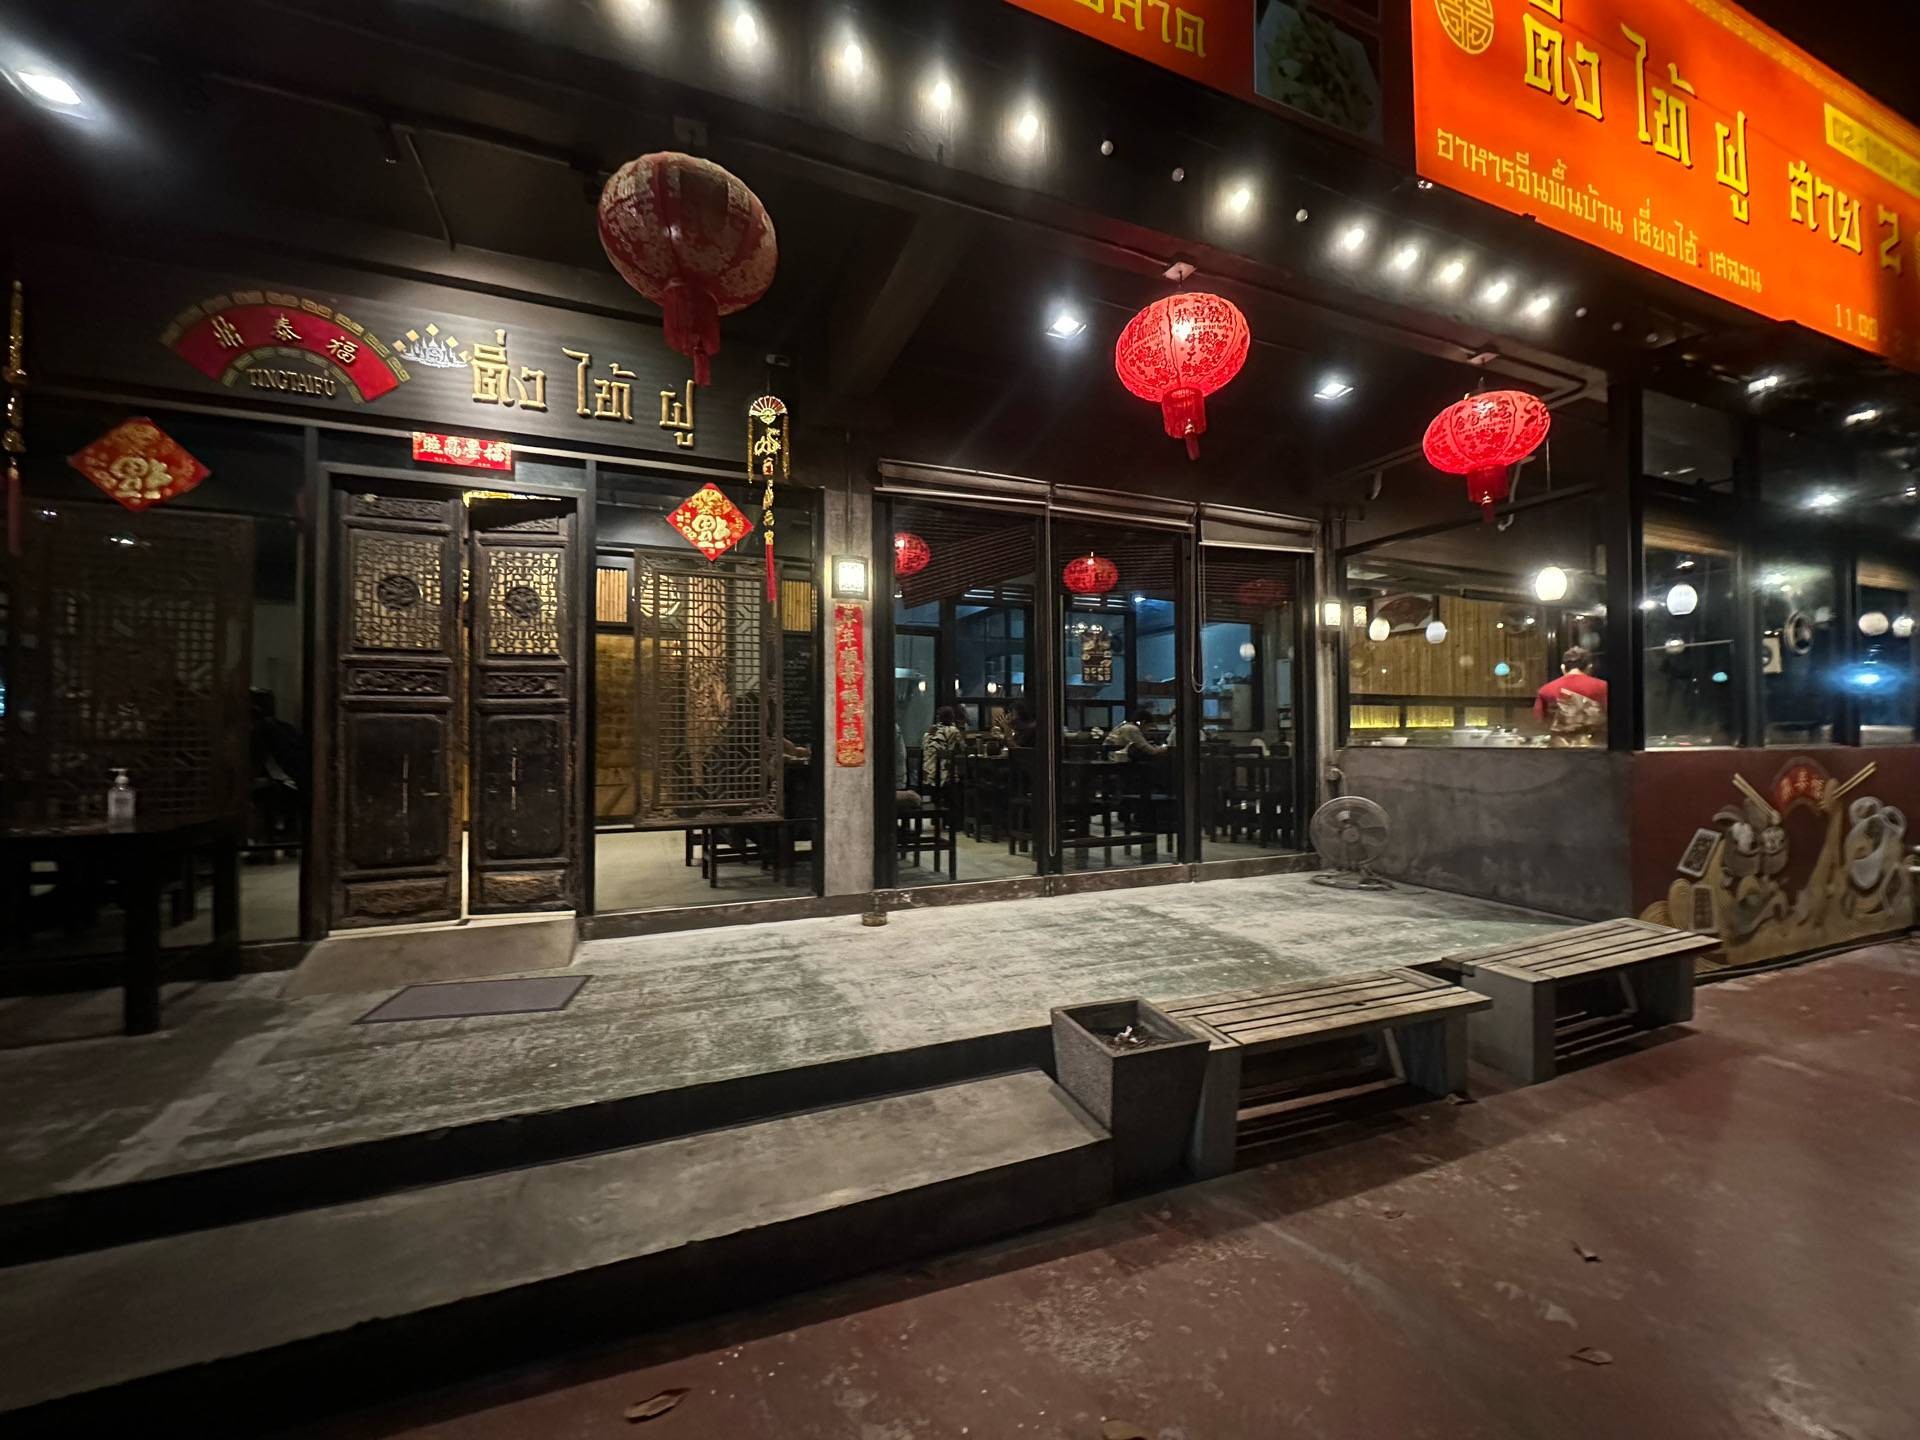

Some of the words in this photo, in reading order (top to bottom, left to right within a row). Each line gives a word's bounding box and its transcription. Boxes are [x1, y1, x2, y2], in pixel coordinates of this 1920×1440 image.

[1436, 127, 1625, 235] อาหารจีนพื้นบ้าน
[1788, 160, 1862, 255] สาย
[1877, 203, 1902, 277] 2
